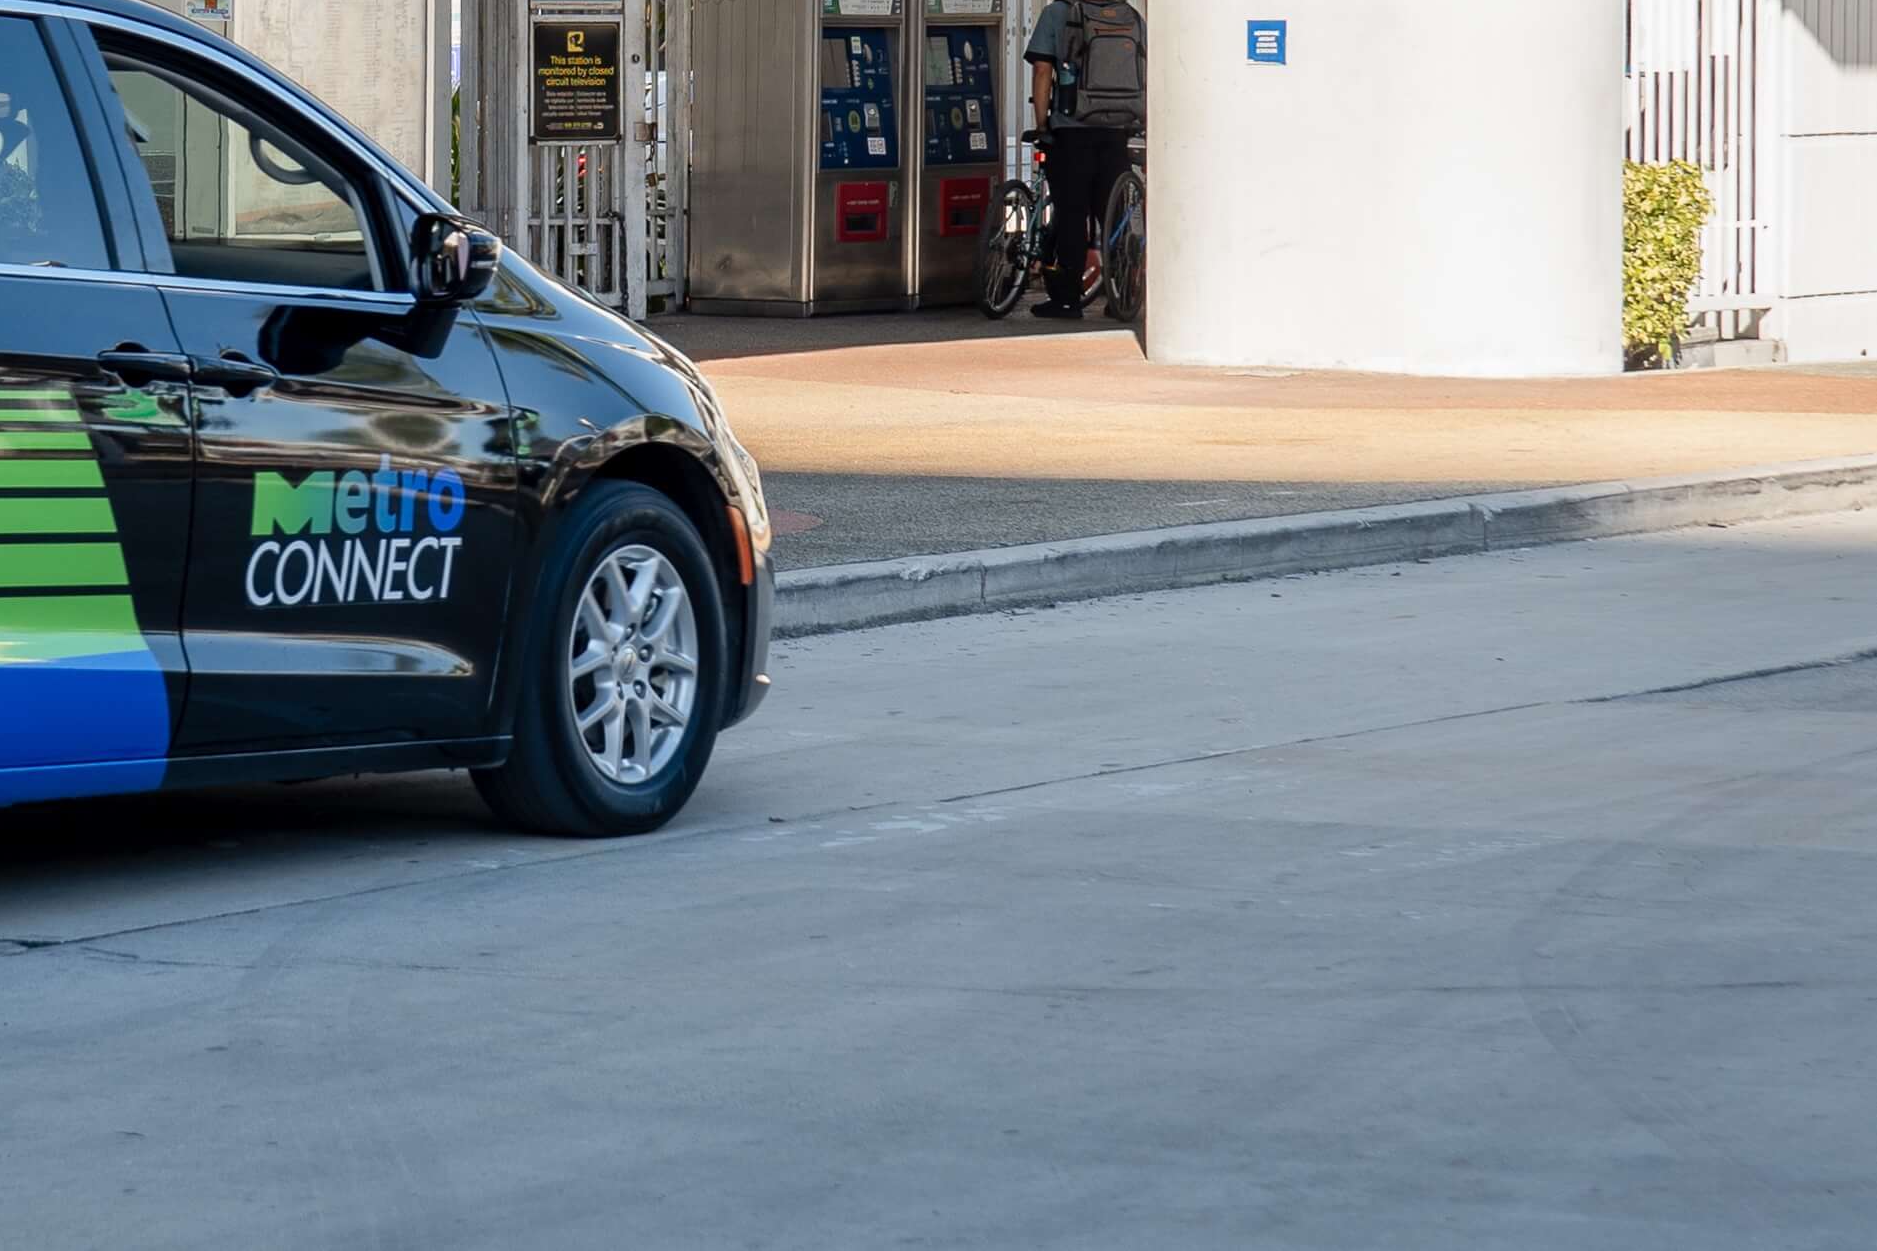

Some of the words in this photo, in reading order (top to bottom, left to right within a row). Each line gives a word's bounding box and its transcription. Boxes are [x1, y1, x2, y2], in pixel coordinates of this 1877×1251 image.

[550, 55, 566, 65] This
[568, 55, 593, 65] station
[594, 55, 602, 65] is
[538, 66, 576, 76] monitored
[577, 66, 587, 78] by
[588, 66, 614, 76] closed
[546, 77, 569, 86] circuit
[570, 77, 606, 86] television
[251, 453, 466, 536] Metro
[246, 536, 463, 607] CONNECT
